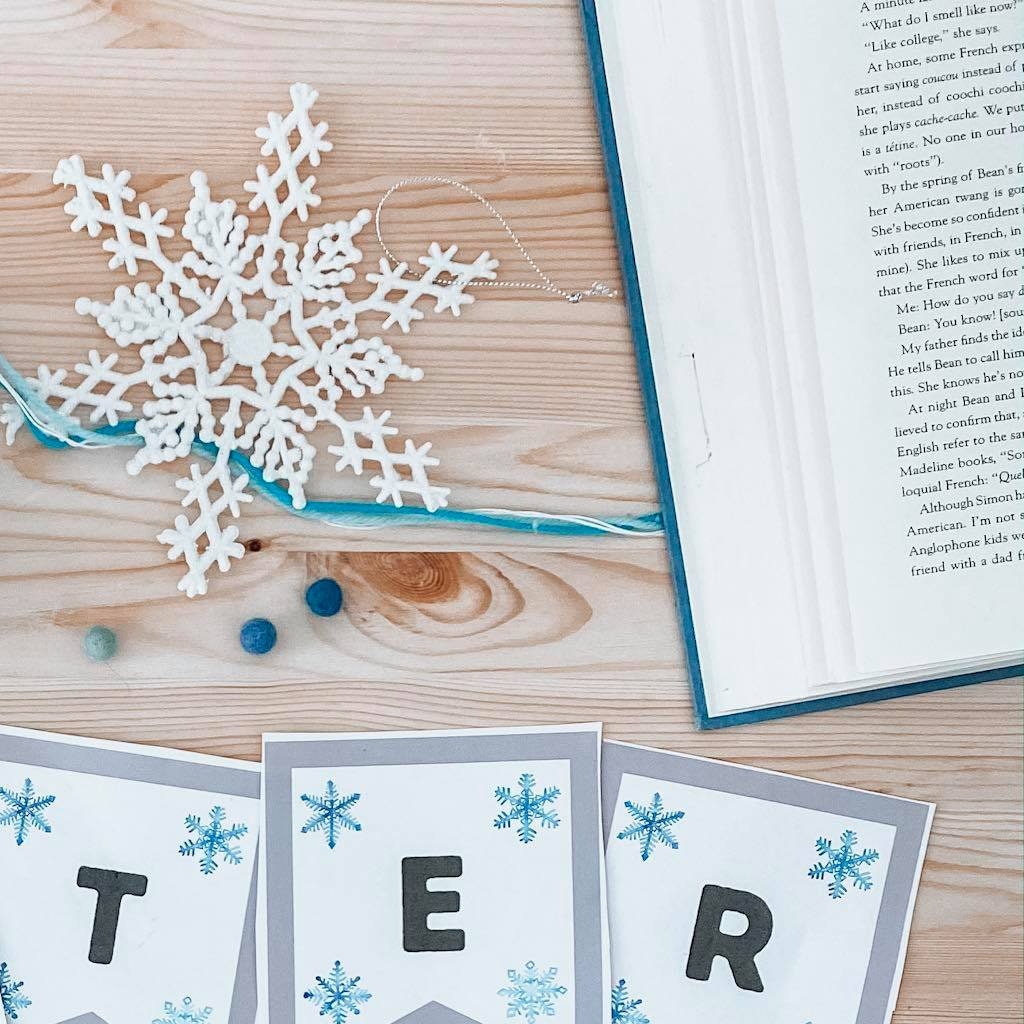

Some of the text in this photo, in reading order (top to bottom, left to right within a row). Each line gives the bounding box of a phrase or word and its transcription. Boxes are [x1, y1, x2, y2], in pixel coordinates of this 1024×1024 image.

[860, 2, 870, 13] A
[862, 18, 902, 30] “What
[906, 14, 921, 25] do
[925, 12, 928, 22] I
[933, 6, 962, 21] smell
[966, 4, 986, 16] like
[865, 26, 1000, 52] “Like college,” she says.
[868, 62, 882, 73] At
[886, 57, 921, 71] home,
[926, 53, 956, 63] some
[959, 43, 998, 58] French
[855, 85, 879, 96] start
[884, 79, 919, 91] saying
[921, 73, 960, 85] coucou
[962, 63, 1001, 78] instead
[1005, 60, 1017, 72] of
[857, 106, 878, 118] her,
[881, 95, 923, 112] instead
[928, 92, 940, 104] of
[946, 87, 984, 102] coochi
[859, 125, 878, 136] she
[880, 121, 911, 135] plays
[915, 108, 979, 127] cache-cache.
[983, 104, 1003, 115] We
[862, 147, 873, 156] is
[886, 141, 919, 152] tétine.
[923, 135, 941, 146] No
[945, 134, 967, 142] one
[971, 130, 982, 139] in
[986, 128, 1006, 136] our
[864, 155, 944, 176] with “roots”).
[882, 184, 896, 194] By
[900, 180, 918, 191] the
[922, 176, 958, 189] spring
[961, 169, 973, 181] of
[977, 165, 1013, 179] Bean’s
[869, 206, 887, 217] her
[894, 198, 950, 213] American
[954, 192, 989, 203] twang
[994, 187, 1003, 197] is
[871, 223, 901, 237] She’s
[904, 218, 948, 231] become
[951, 216, 963, 224] so
[966, 206, 1019, 222] confident
[874, 226, 1021, 256] with friends, in French, in
[876, 262, 912, 277] mine).
[917, 259, 939, 270] She
[942, 255, 968, 266] likes
[973, 252, 984, 262] to
[989, 249, 1010, 261] mix
[879, 267, 1018, 297] that the French word for
[897, 303, 919, 314] Me:
[923, 299, 951, 311] How
[954, 294, 969, 305] do
[973, 294, 994, 304] you
[998, 290, 1014, 299] say
[898, 321, 930, 335] Bean:
[934, 318, 957, 329] You
[961, 310, 996, 325] know!
[901, 343, 922, 355] My
[925, 338, 958, 351] father
[961, 332, 990, 345] finds
[991, 330, 1009, 341] the
[888, 366, 904, 377] He
[908, 361, 931, 375] tells
[934, 359, 962, 370] Bean
[966, 357, 978, 365] to
[980, 350, 1001, 363] call
[890, 386, 914, 397] this.
[918, 381, 939, 393] She
[943, 377, 980, 389] knows
[983, 370, 1005, 383] he’s
[908, 404, 923, 415] At
[928, 399, 957, 412] night
[962, 396, 990, 406] Bean
[995, 389, 1015, 401] and
[895, 422, 928, 437] lieved
[946, 415, 991, 429] confirm
[994, 411, 1020, 422] that,
[897, 441, 939, 457] English
[943, 438, 970, 450] refer
[973, 437, 985, 445] to
[989, 432, 1007, 443] the
[900, 462, 954, 477] Madeline
[958, 454, 996, 468] books,
[902, 481, 942, 497] loquial
[945, 475, 988, 490] French:
[920, 497, 974, 514] Although
[976, 494, 1013, 506] Simon
[972, 516, 991, 527] I’m
[996, 514, 1016, 523] not
[909, 540, 982, 556] Anglophone
[984, 532, 1008, 545] kids
[911, 561, 946, 576] friend
[951, 556, 976, 570] with
[990, 551, 1012, 564] dad
